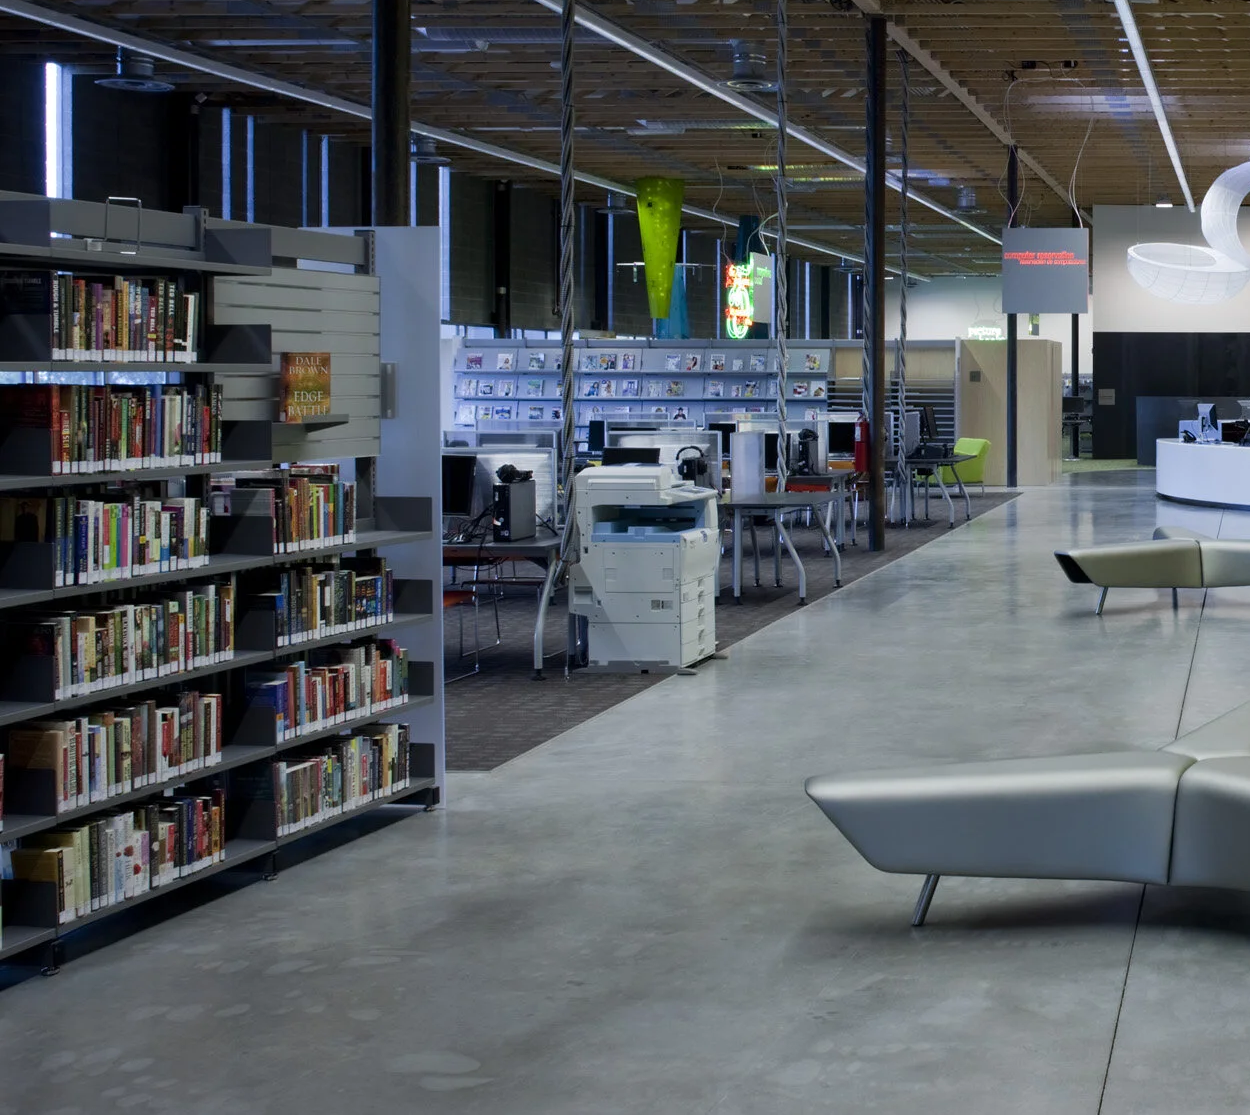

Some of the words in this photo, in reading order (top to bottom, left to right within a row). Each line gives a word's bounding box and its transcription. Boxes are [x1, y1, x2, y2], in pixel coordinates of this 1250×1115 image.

[295, 356, 322, 365] DALE
[289, 366, 328, 374] BROWN
[294, 390, 325, 402] EDGE
